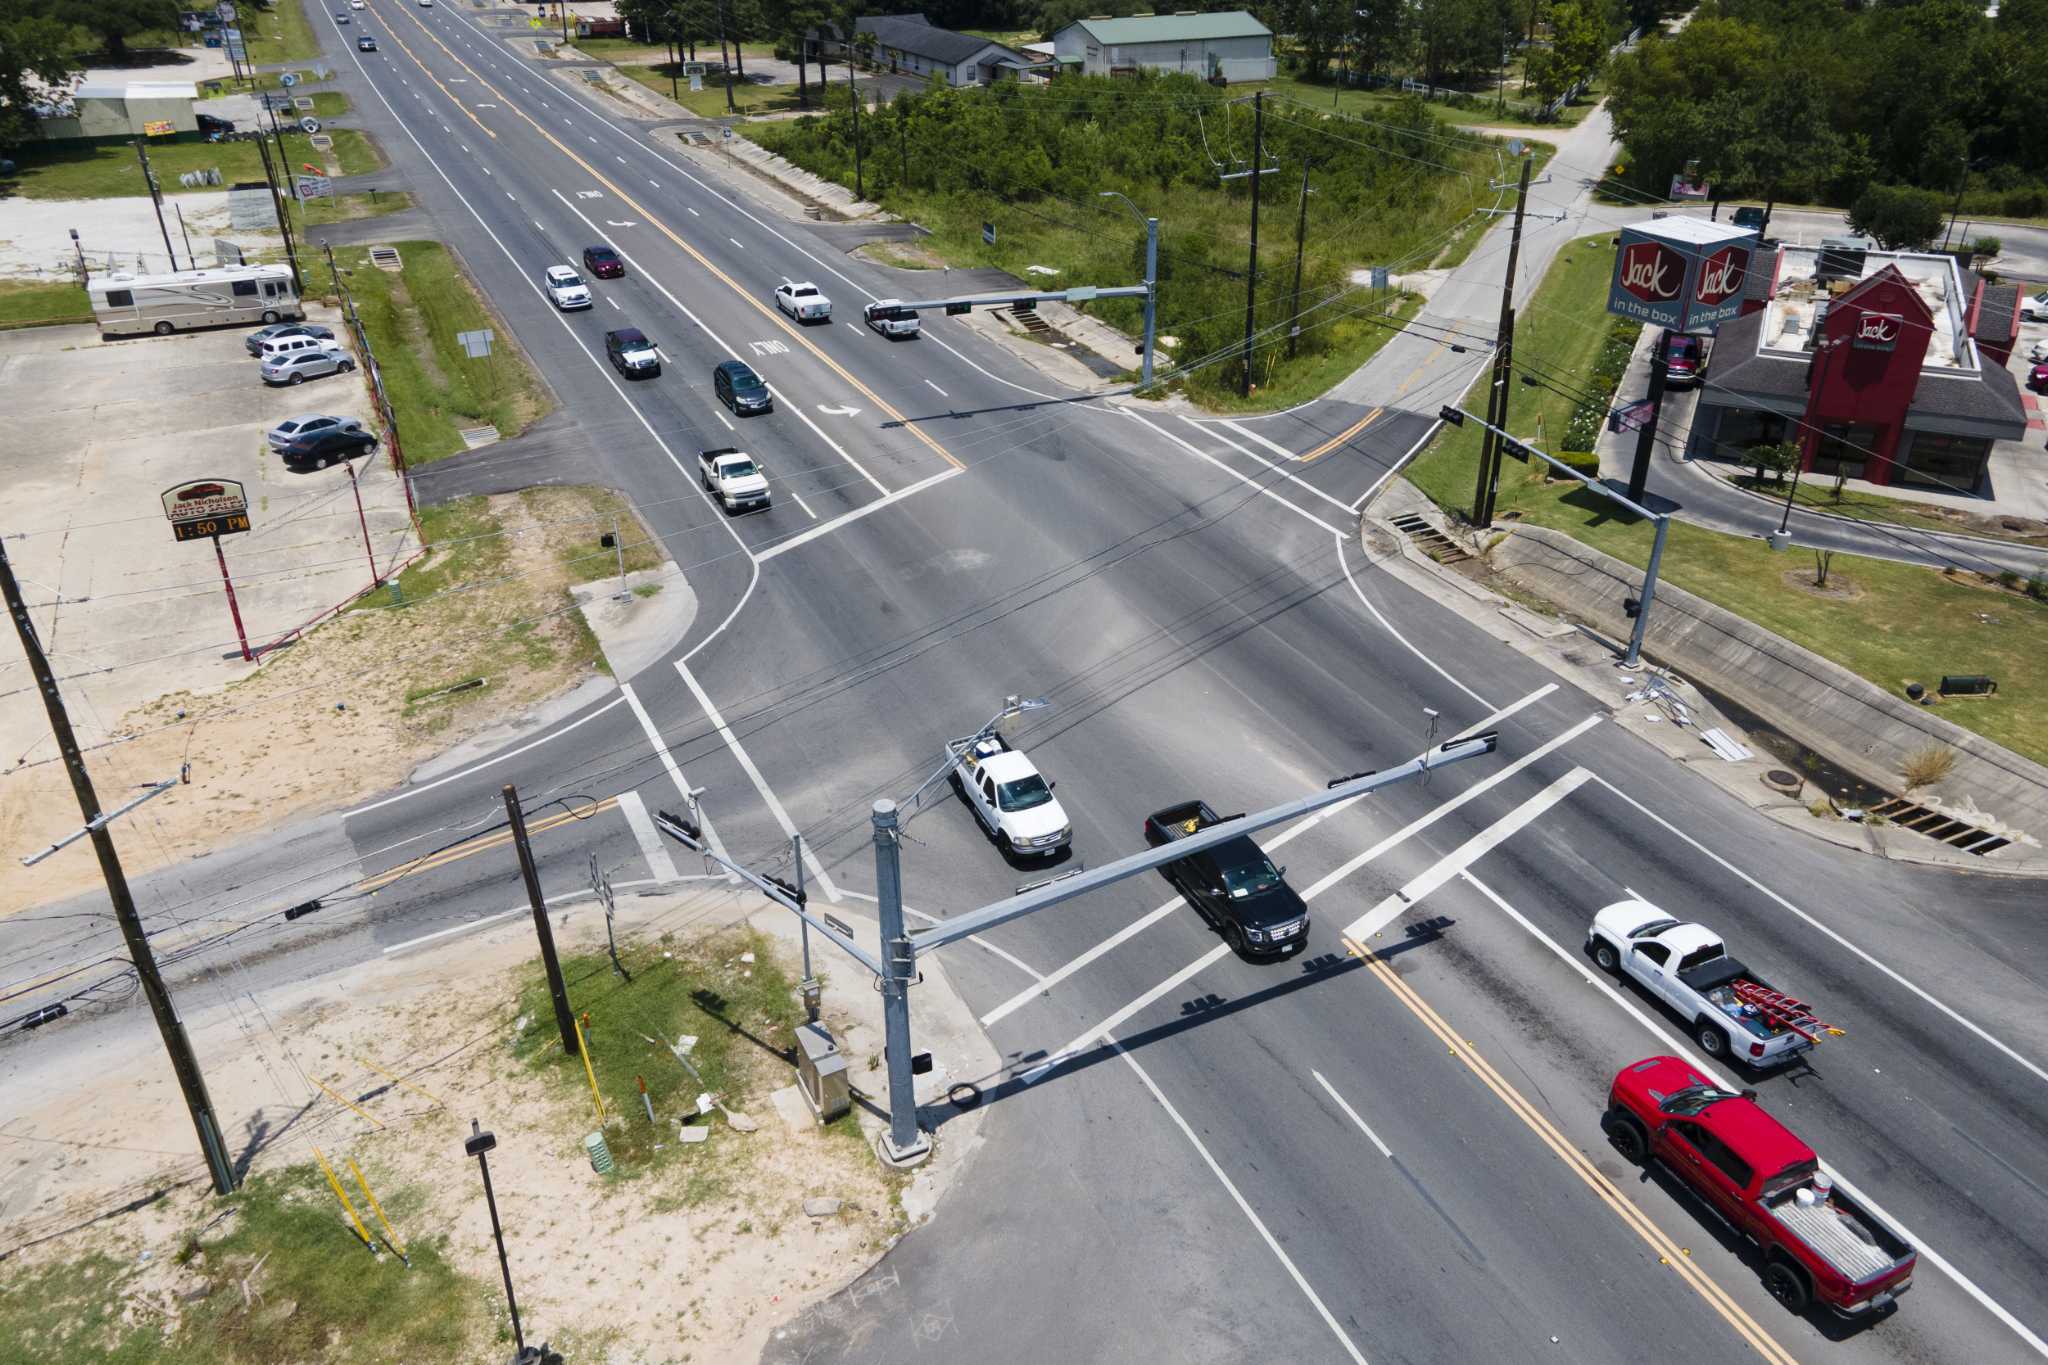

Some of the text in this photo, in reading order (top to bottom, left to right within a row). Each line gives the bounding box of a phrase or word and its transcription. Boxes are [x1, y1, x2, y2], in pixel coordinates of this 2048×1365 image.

[1622, 249, 1680, 297] Jack
[1697, 252, 1743, 300] Jack
[1614, 297, 1678, 325] in the box
[1689, 306, 1737, 325] in the box
[1857, 319, 1897, 341] Jack
[170, 500, 244, 519] AUTO SALES
[173, 495, 238, 510] Jack Nicholson
[176, 516, 249, 538] 1:50 PM
